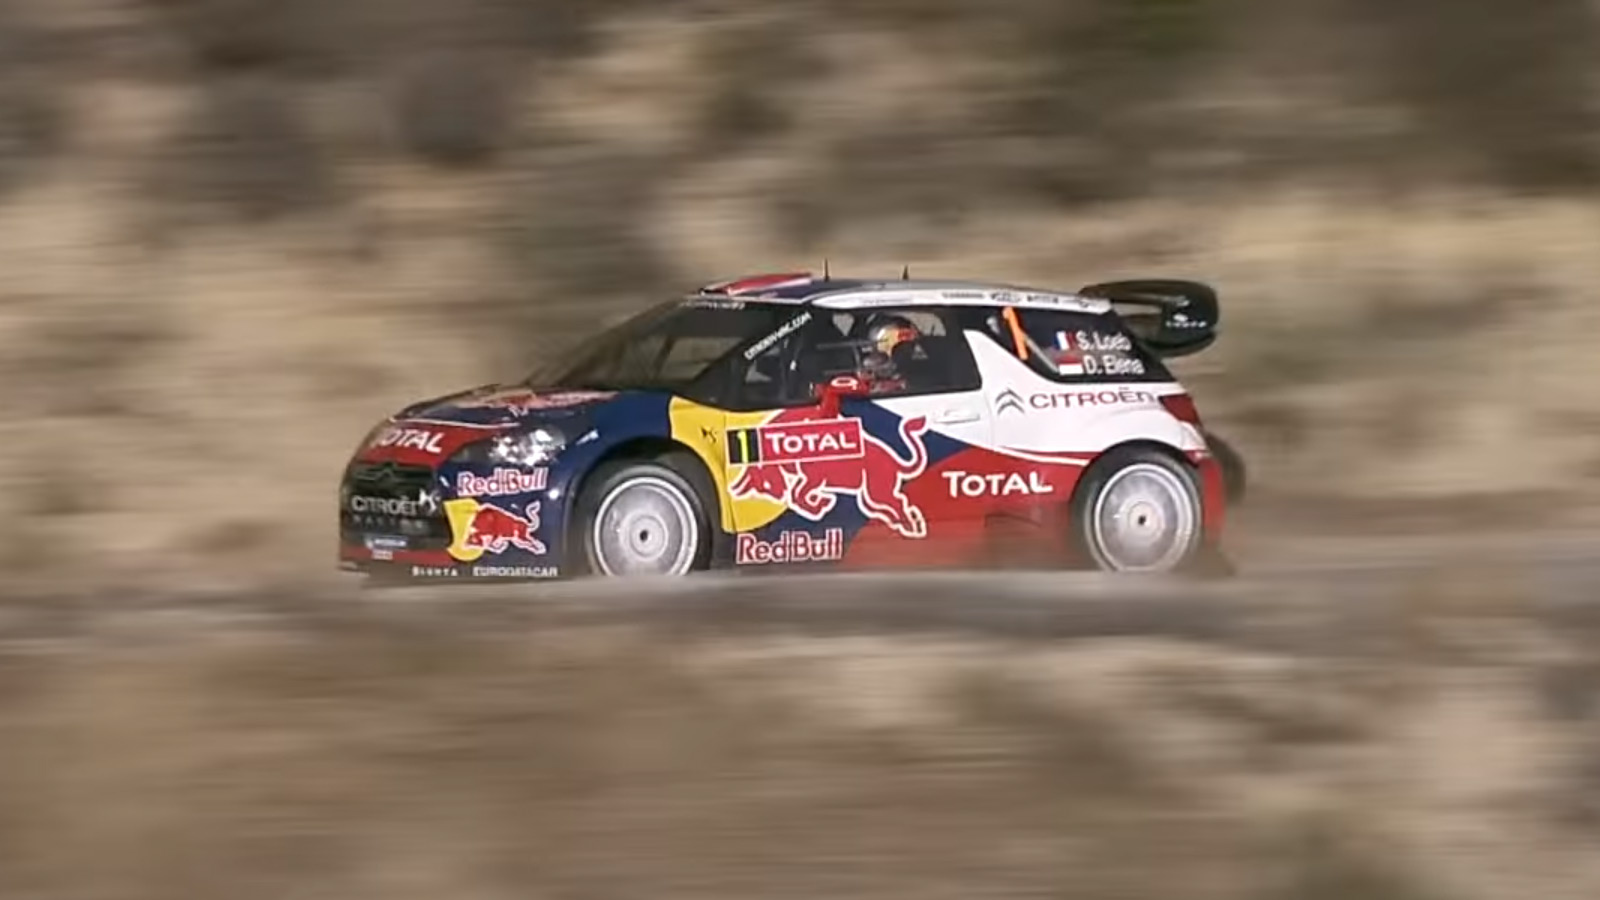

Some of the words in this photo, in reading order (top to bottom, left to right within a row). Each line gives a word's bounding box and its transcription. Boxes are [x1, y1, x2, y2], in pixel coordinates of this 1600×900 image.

[737, 430, 749, 463] 1
[765, 431, 857, 454] TOTAL
[941, 471, 1054, 498] TOTAL
